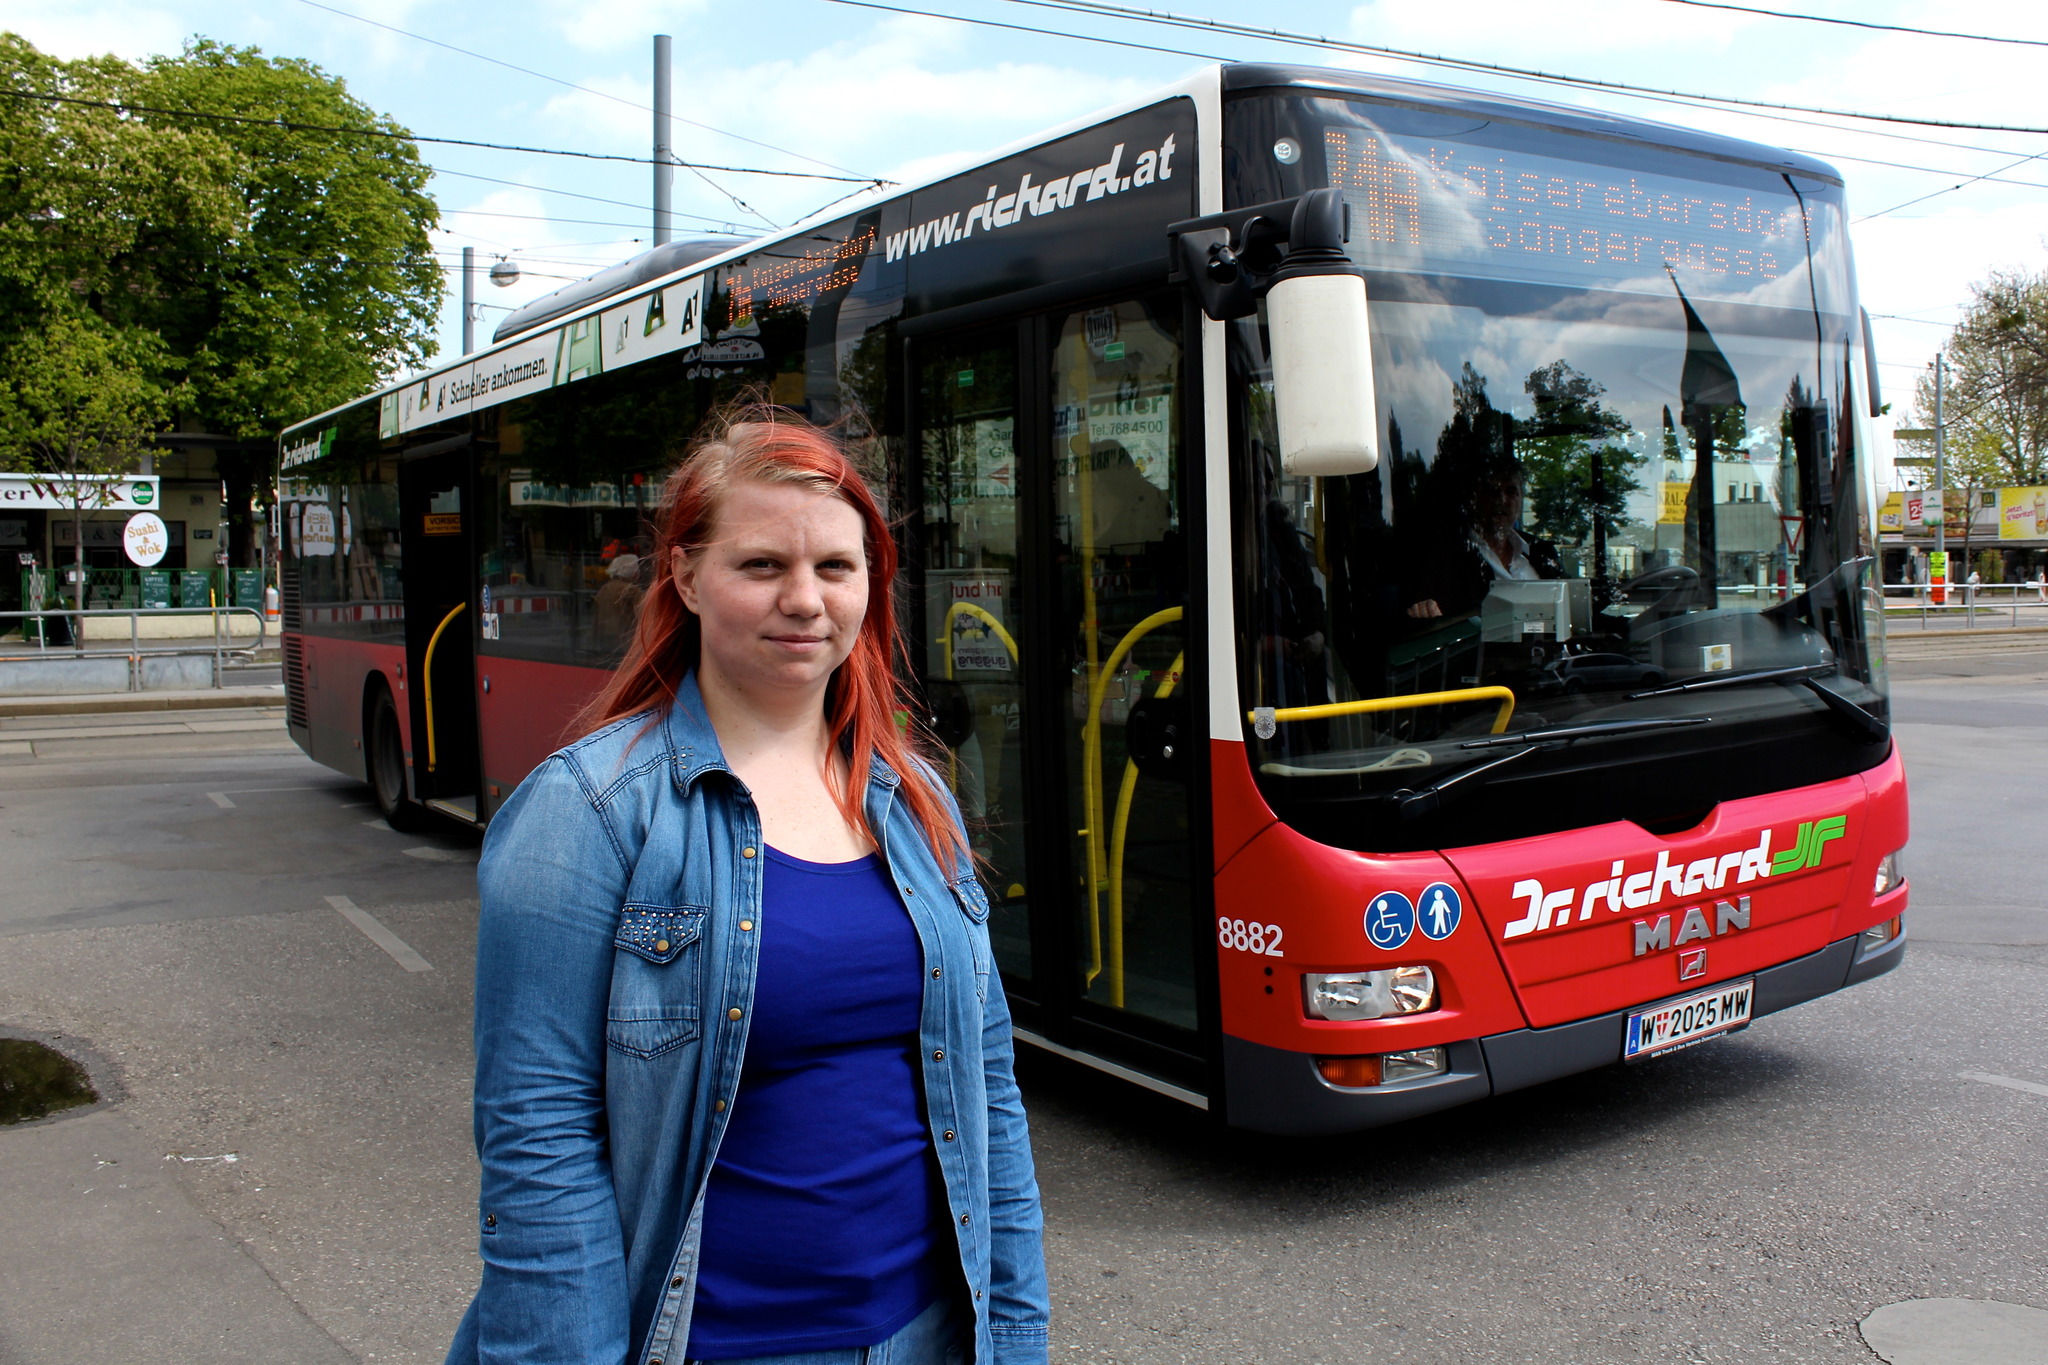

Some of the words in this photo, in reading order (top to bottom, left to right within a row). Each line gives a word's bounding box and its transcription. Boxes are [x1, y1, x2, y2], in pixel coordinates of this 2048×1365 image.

[885, 132, 1175, 264] www.richard.at
[450, 372, 491, 404] Schneller
[491, 357, 548, 391] ankommen.
[127, 521, 158, 538] Sushi
[429, 516, 461, 526] VORSIC
[135, 543, 162, 557] Wok
[1579, 829, 1773, 922] richard
[1218, 916, 1285, 958] 8882
[1632, 895, 1752, 958] MAN
[1641, 1015, 1656, 1046] W
[1670, 997, 1718, 1037] 2025
[1720, 988, 1749, 1021] MW
